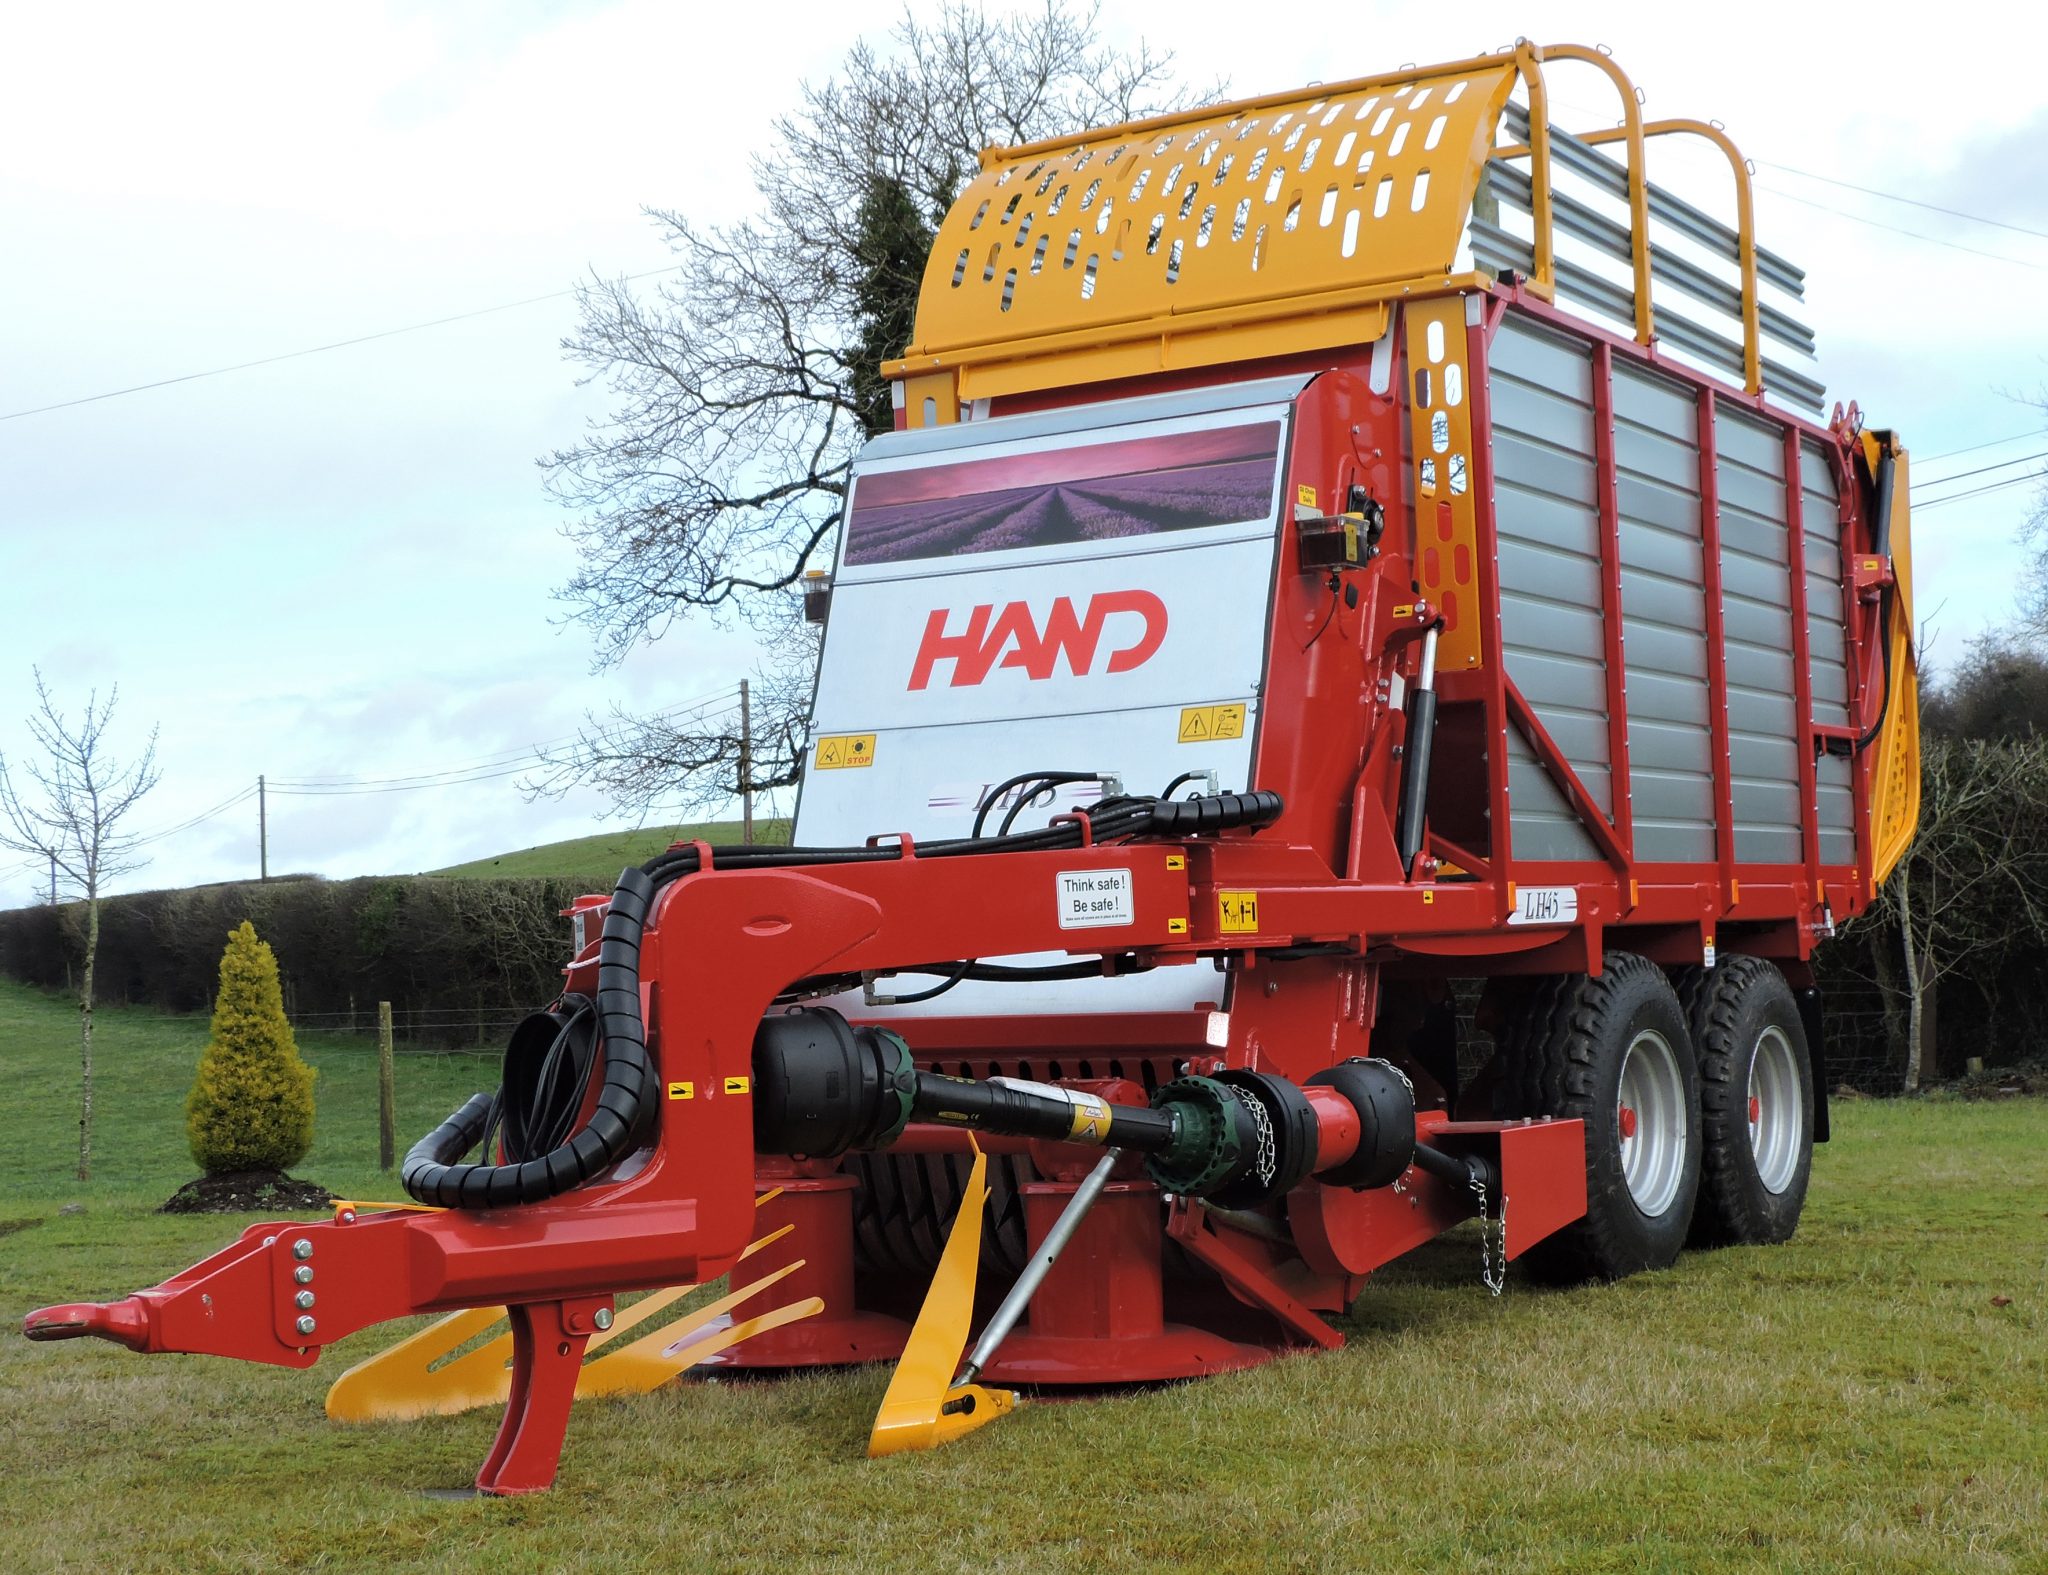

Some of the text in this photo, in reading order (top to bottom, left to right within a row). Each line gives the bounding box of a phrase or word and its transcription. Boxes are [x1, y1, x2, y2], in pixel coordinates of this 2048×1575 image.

[907, 590, 1168, 691] HAND
[847, 756, 870, 765] STOP
[1064, 878, 1095, 892] Think
[1073, 900, 1088, 912] Be
[1525, 891, 1559, 919] LH45
